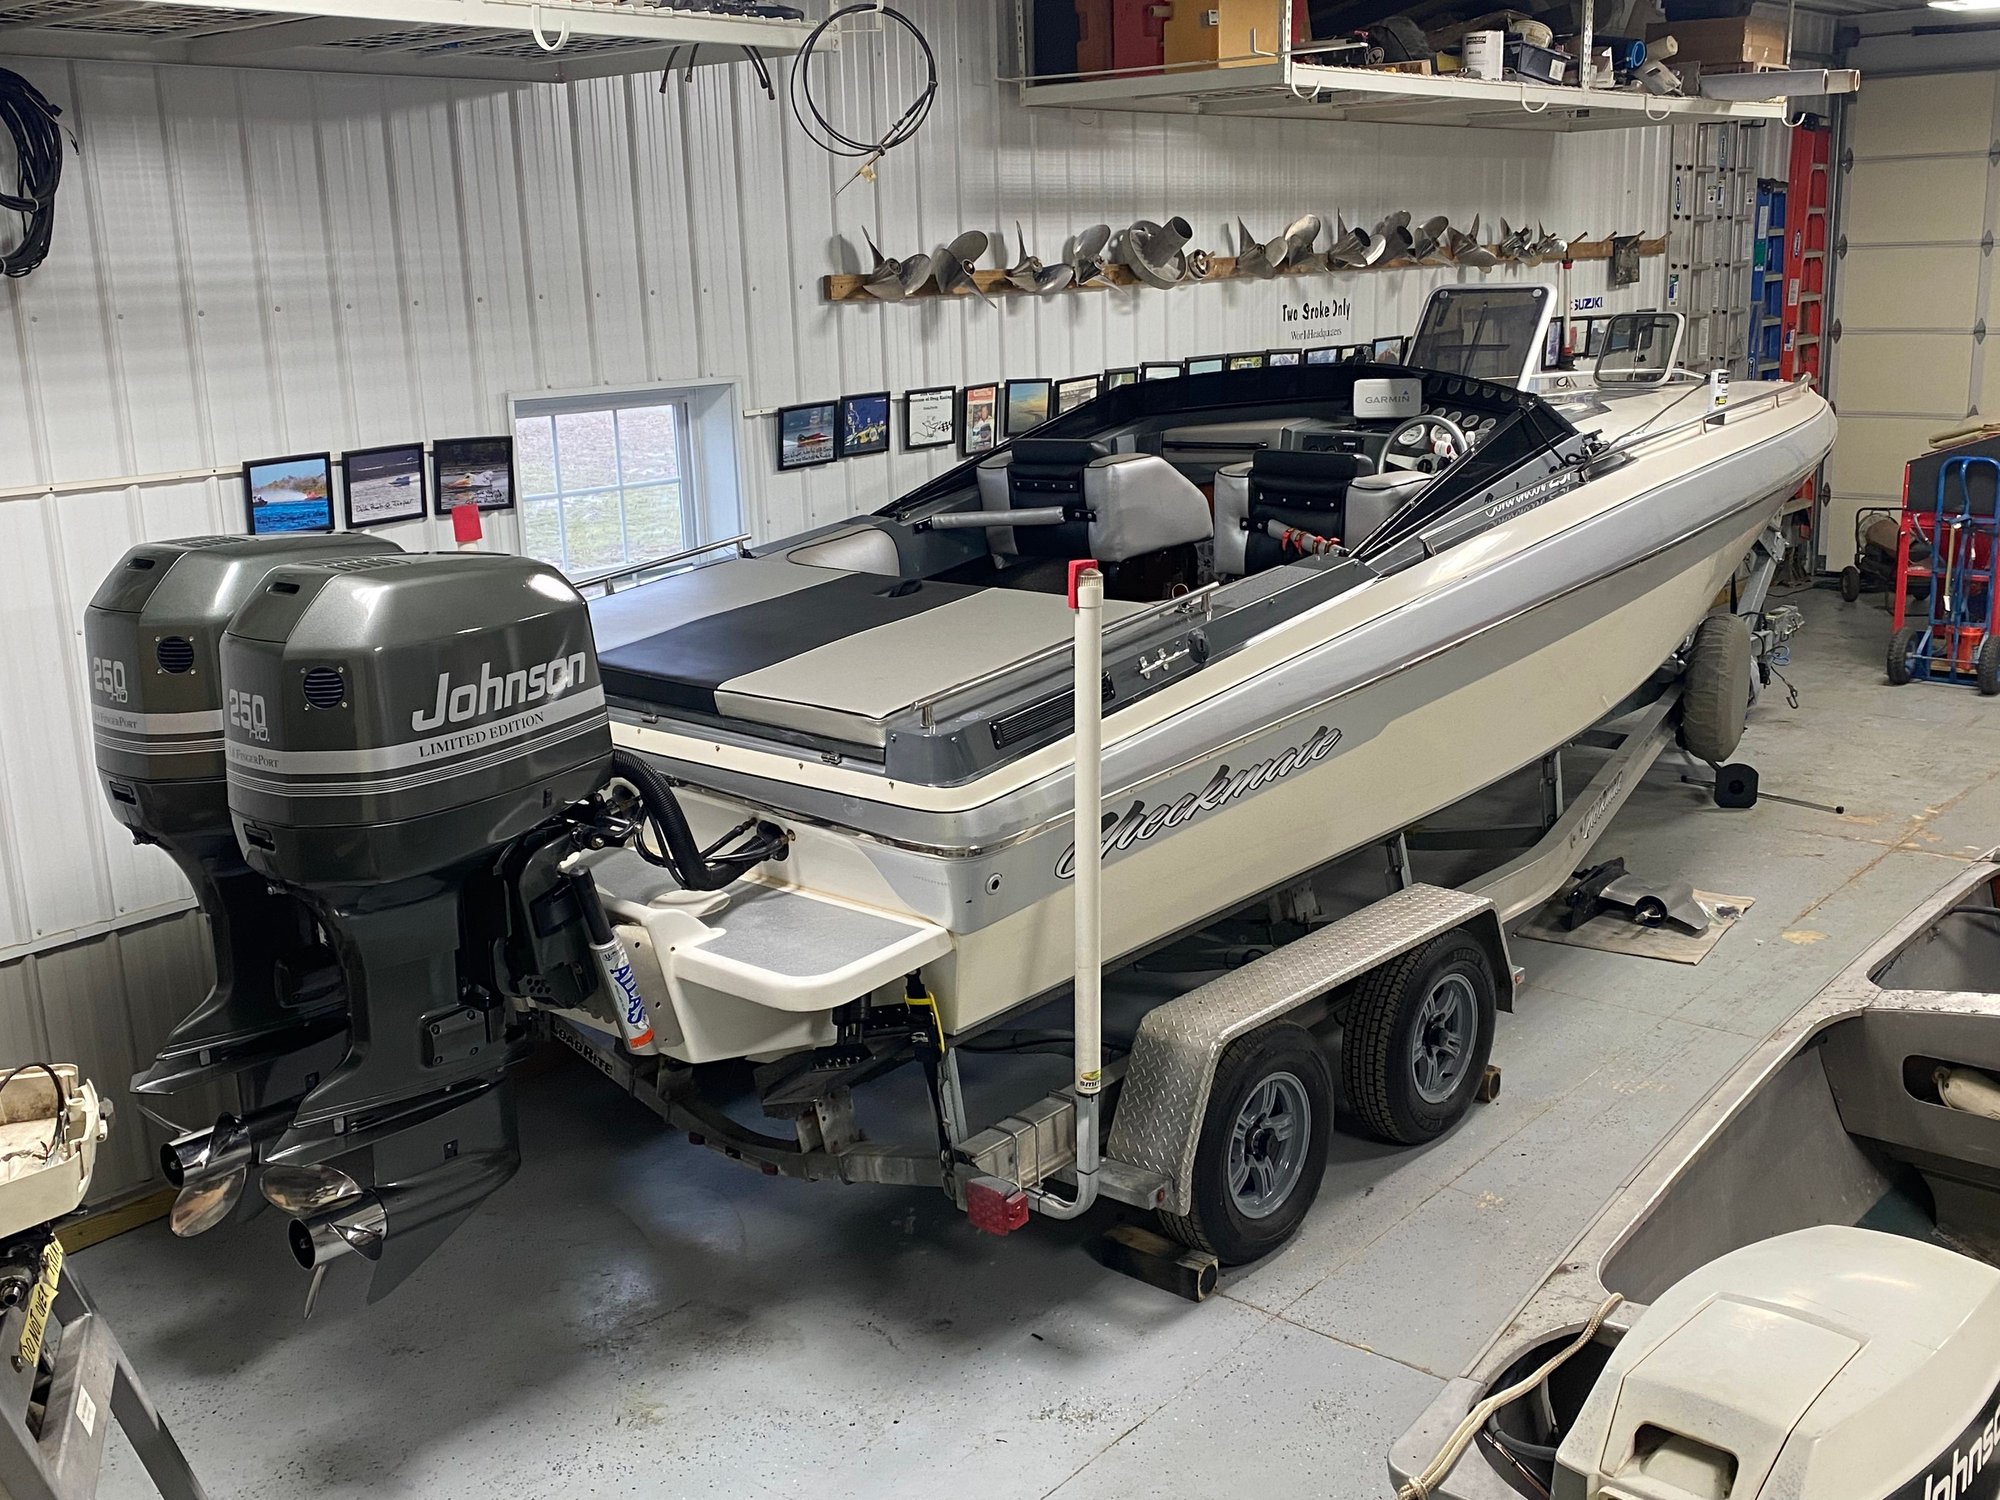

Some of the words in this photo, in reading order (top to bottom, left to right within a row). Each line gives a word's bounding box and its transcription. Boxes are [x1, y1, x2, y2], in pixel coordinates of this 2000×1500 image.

[1282, 304, 1298, 322] Two
[1364, 395, 1410, 404] GARMIN
[93, 656, 126, 693] 250
[411, 651, 586, 732] Johnson
[229, 688, 267, 730] 250
[418, 730, 487, 757] LIMITED
[488, 711, 545, 739] EDITION
[1055, 726, 1342, 879] Checkmate
[27, 1309, 43, 1349] NOT
